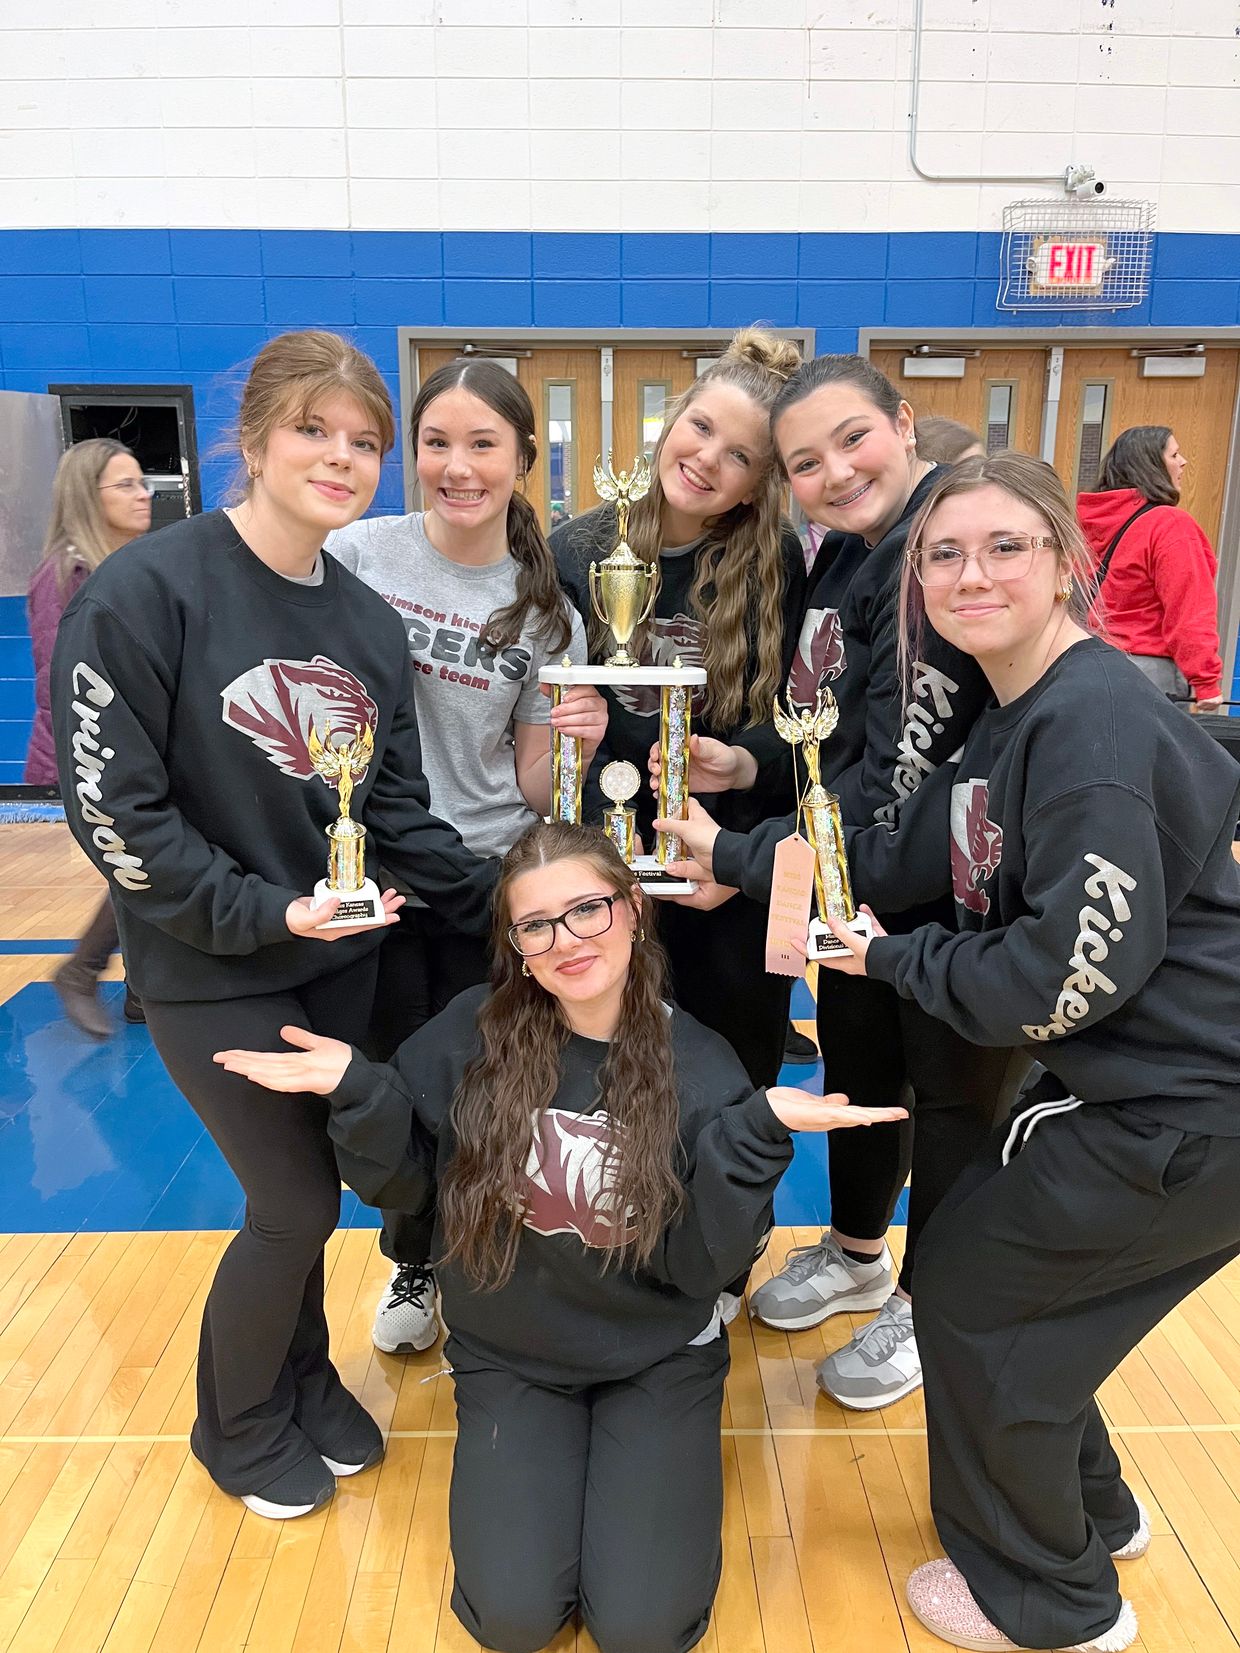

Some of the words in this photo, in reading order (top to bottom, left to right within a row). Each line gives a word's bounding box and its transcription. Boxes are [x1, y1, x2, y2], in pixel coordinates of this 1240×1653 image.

[1048, 244, 1098, 284] EXIT
[380, 593, 446, 624] rimson
[402, 617, 531, 681] GERS
[440, 665, 490, 691] team
[71, 661, 152, 891] Crimson
[1020, 852, 1138, 1042] Kickers
